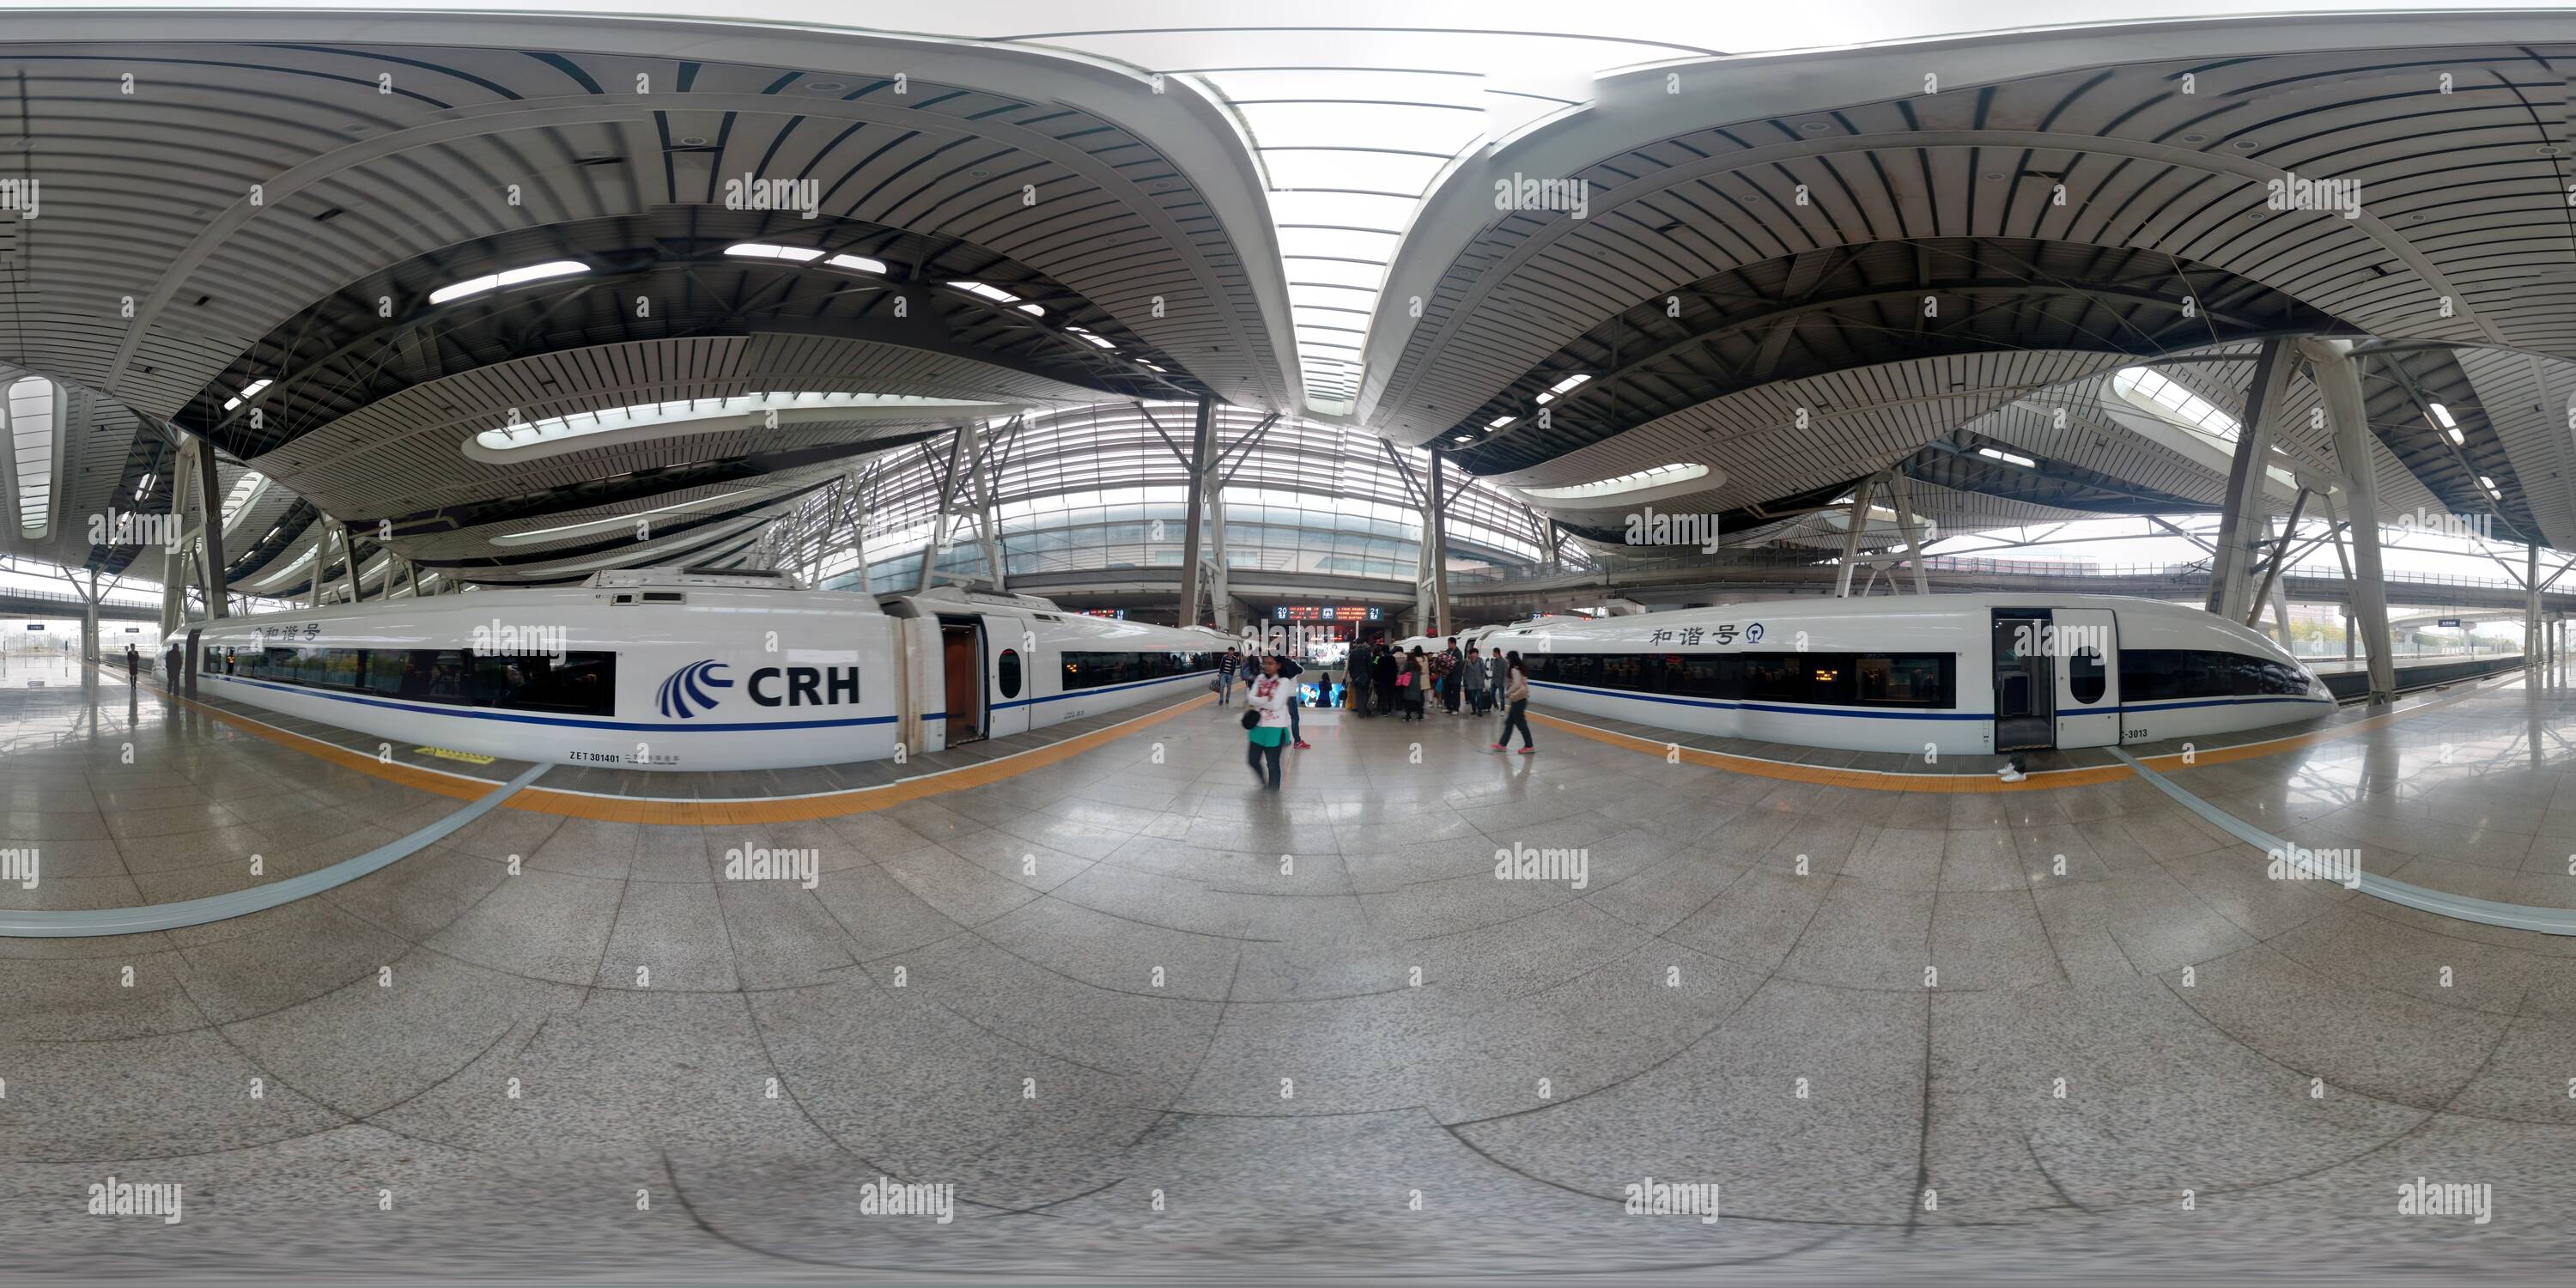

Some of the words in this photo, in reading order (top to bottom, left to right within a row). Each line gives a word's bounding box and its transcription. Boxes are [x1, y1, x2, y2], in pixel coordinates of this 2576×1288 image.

[264, 623, 321, 641] 和谐号
[1649, 625, 1740, 646] 和谐号
[748, 667, 860, 707] CRH
[590, 753, 619, 763] 301401
